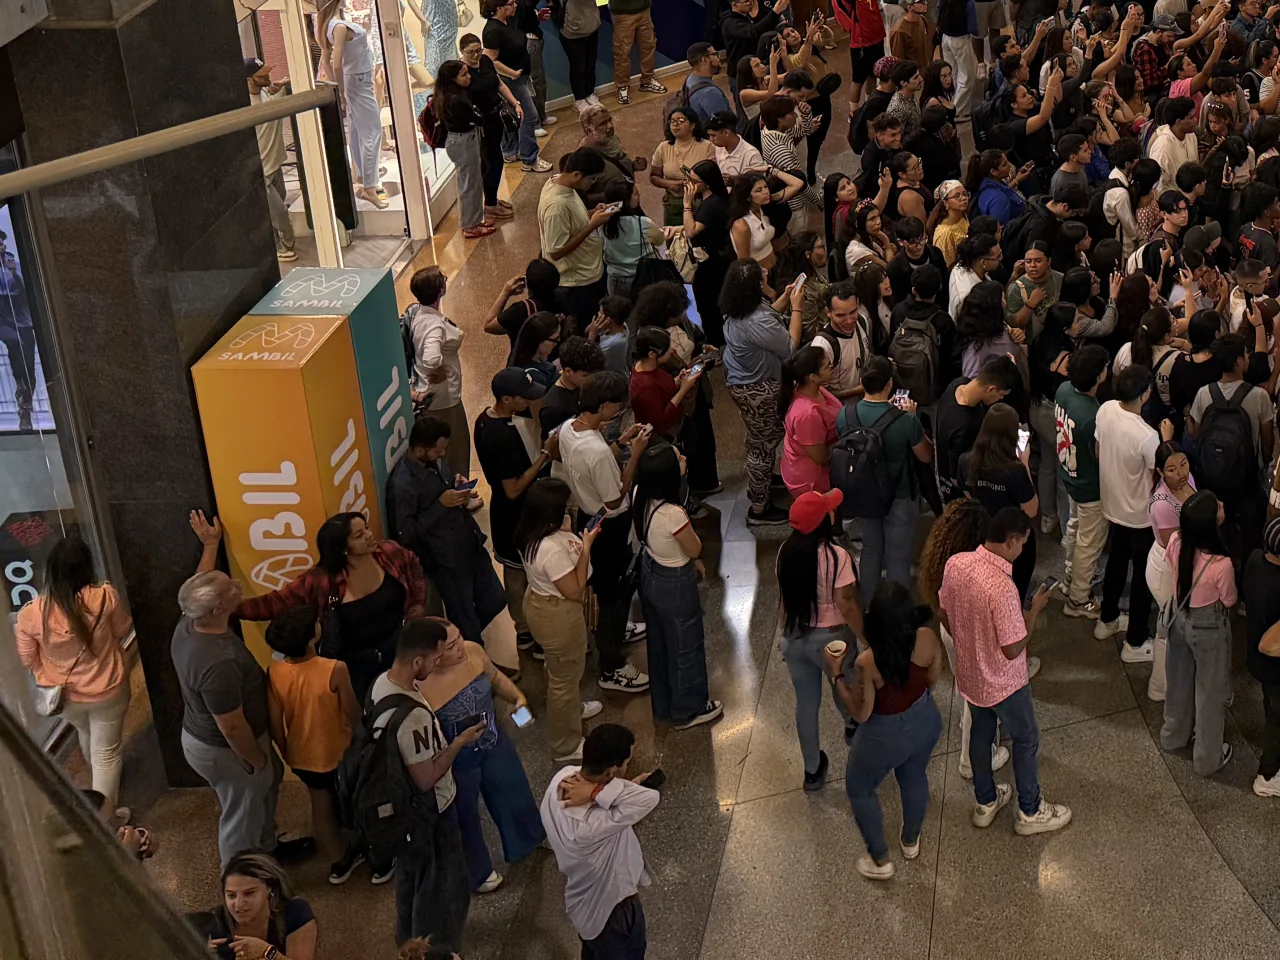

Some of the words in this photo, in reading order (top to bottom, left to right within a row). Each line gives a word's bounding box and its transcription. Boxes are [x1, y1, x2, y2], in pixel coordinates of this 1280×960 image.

[270, 299, 344, 309] SAMBIL
[218, 351, 296, 361] SAMBIL
[977, 480, 1006, 492] BEYOND
